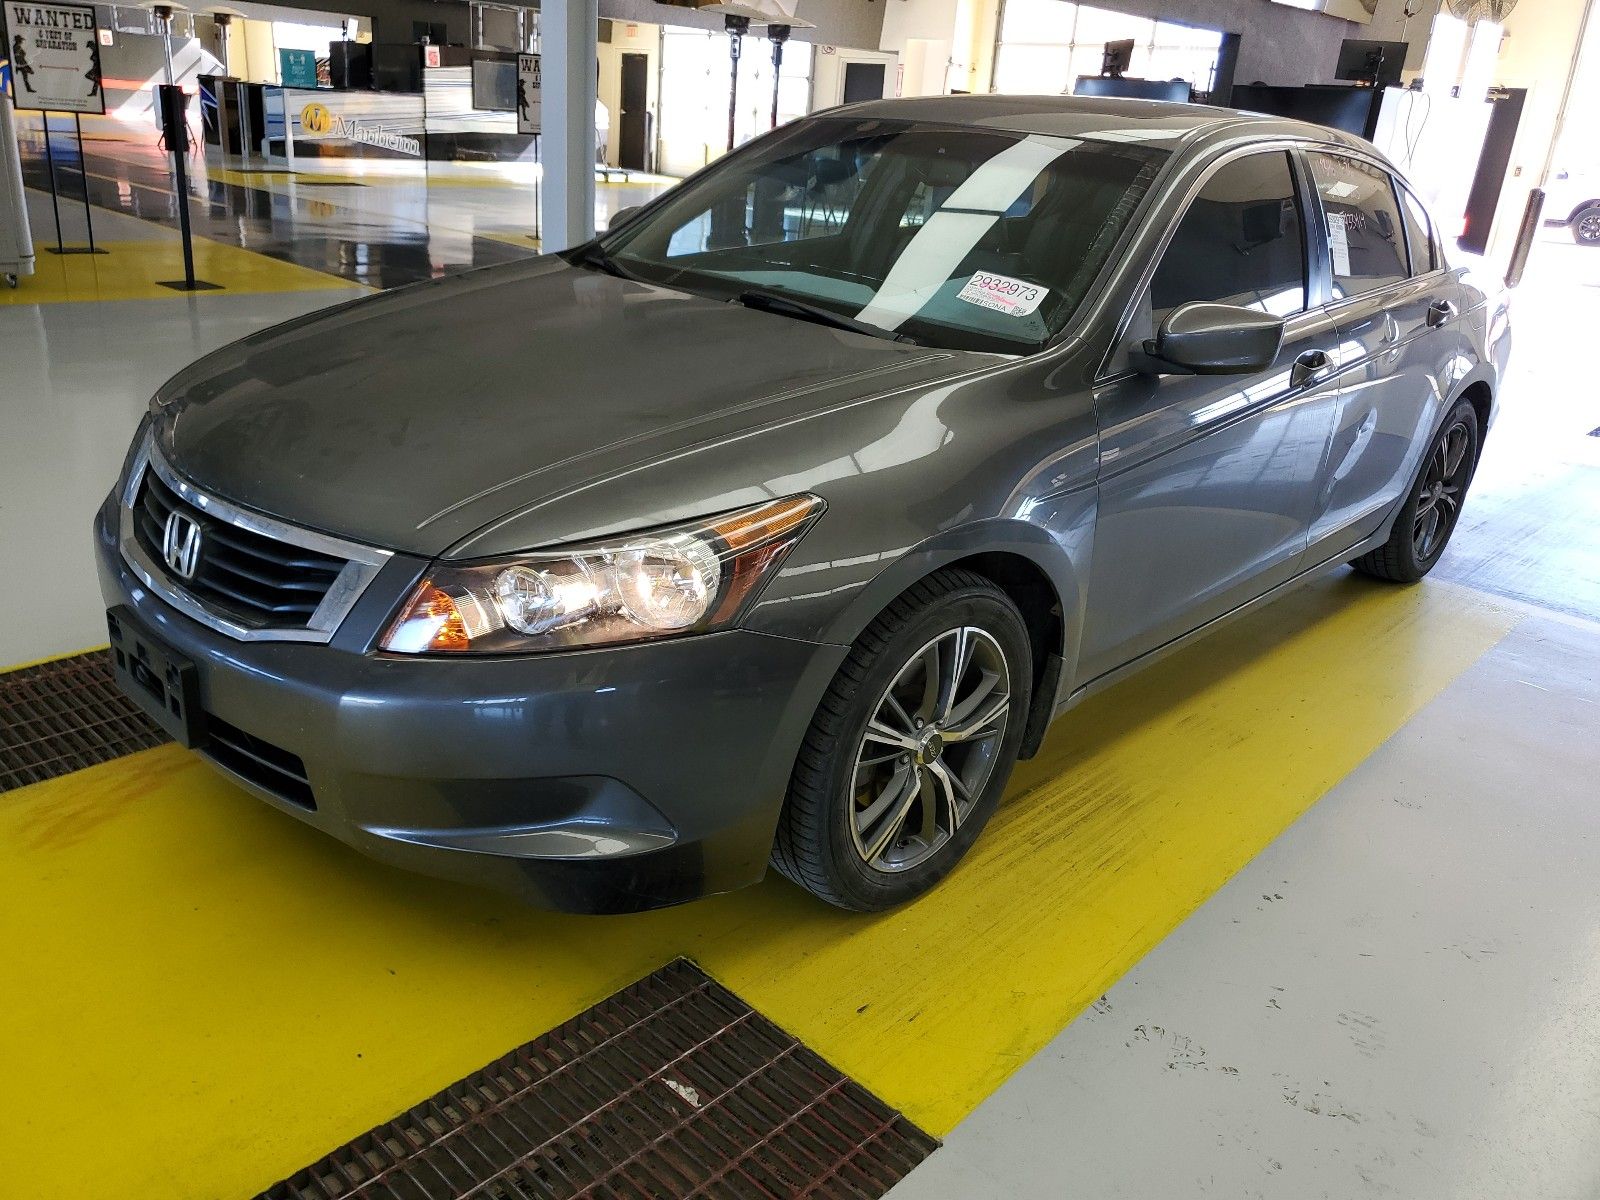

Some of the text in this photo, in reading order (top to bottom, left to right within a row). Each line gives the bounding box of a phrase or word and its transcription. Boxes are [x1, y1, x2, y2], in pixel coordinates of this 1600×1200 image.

[13, 7, 95, 30] WANTED
[334, 113, 421, 156] Manheim
[969, 274, 1039, 301] 2932973
